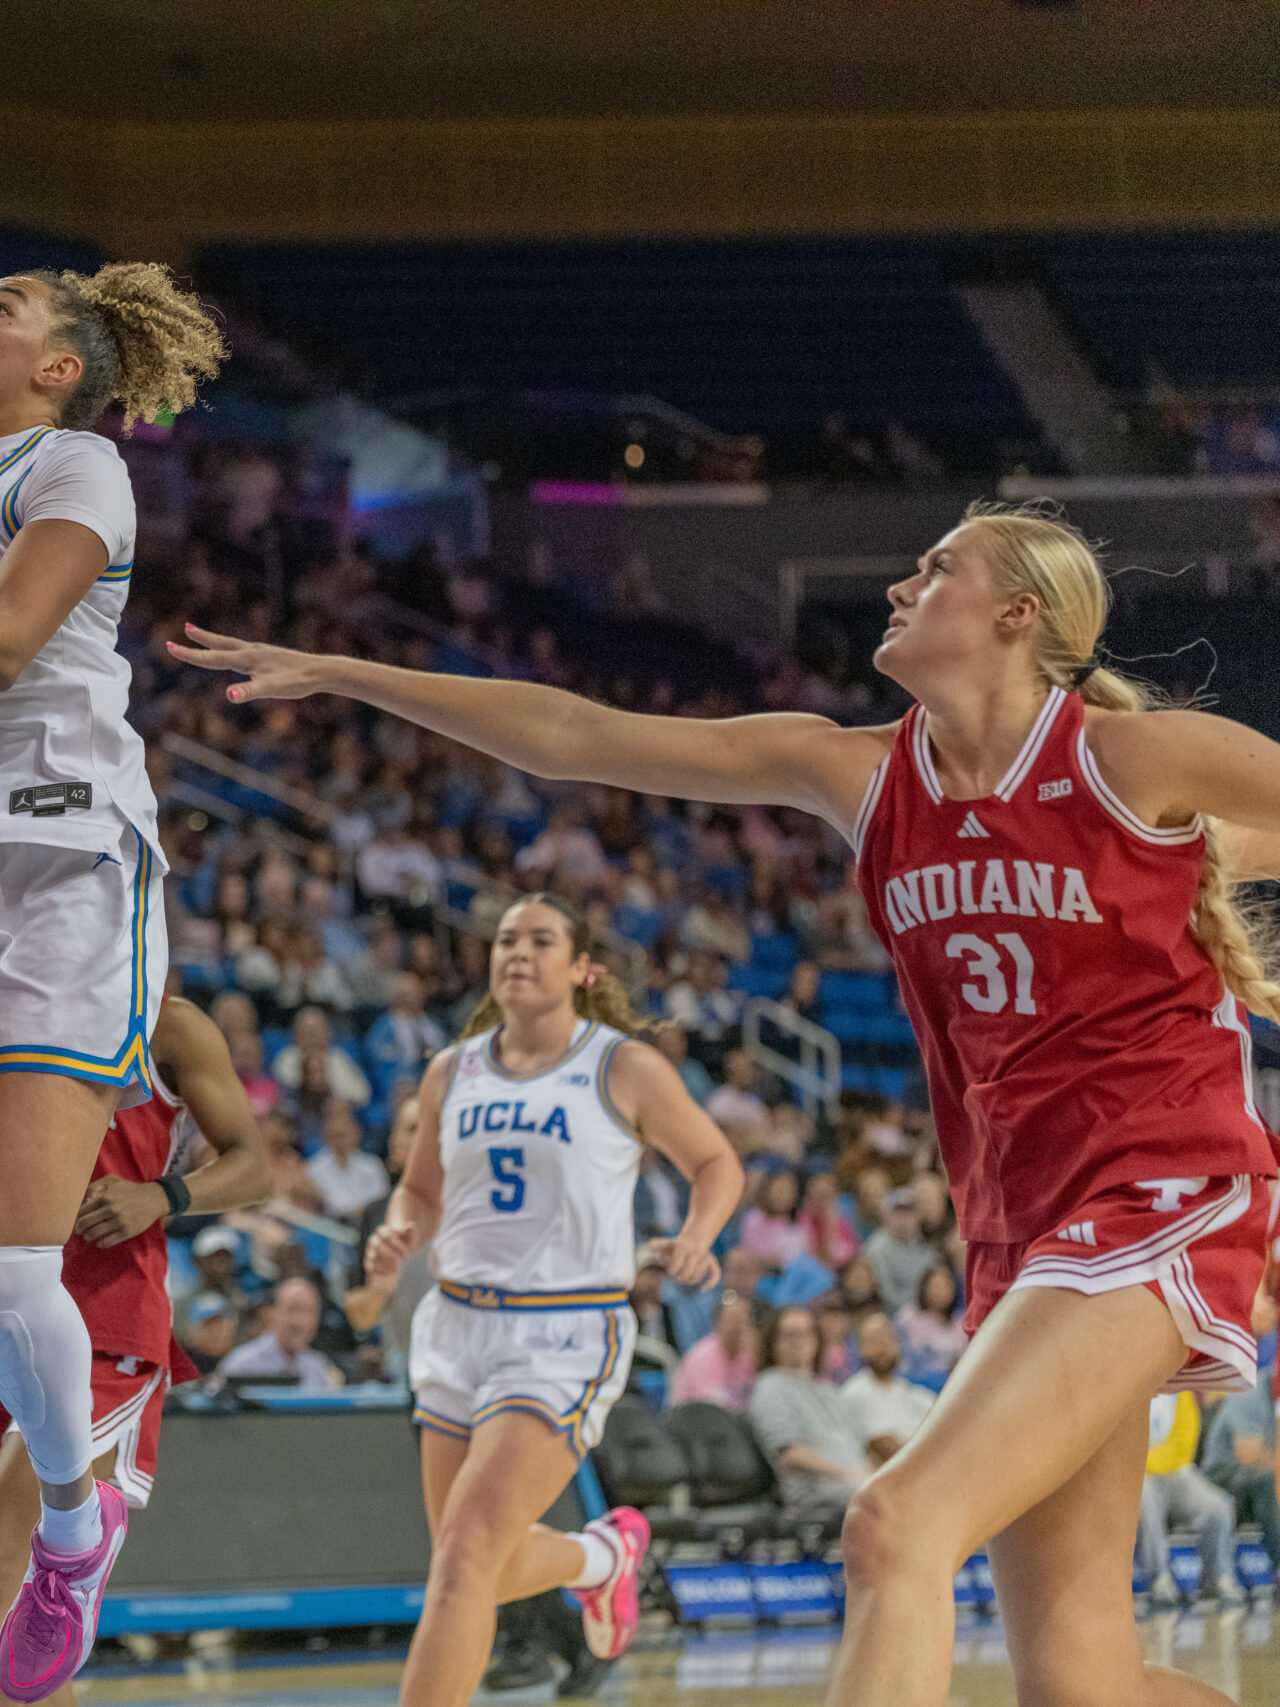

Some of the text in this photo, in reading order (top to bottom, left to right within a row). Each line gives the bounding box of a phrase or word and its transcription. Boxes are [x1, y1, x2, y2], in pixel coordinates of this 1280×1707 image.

[70, 789, 86, 800] 42
[885, 858, 1104, 936] INDIANA
[945, 932, 1037, 1016] 31
[458, 1101, 572, 1144] UCLA
[489, 1147, 525, 1213] 5
